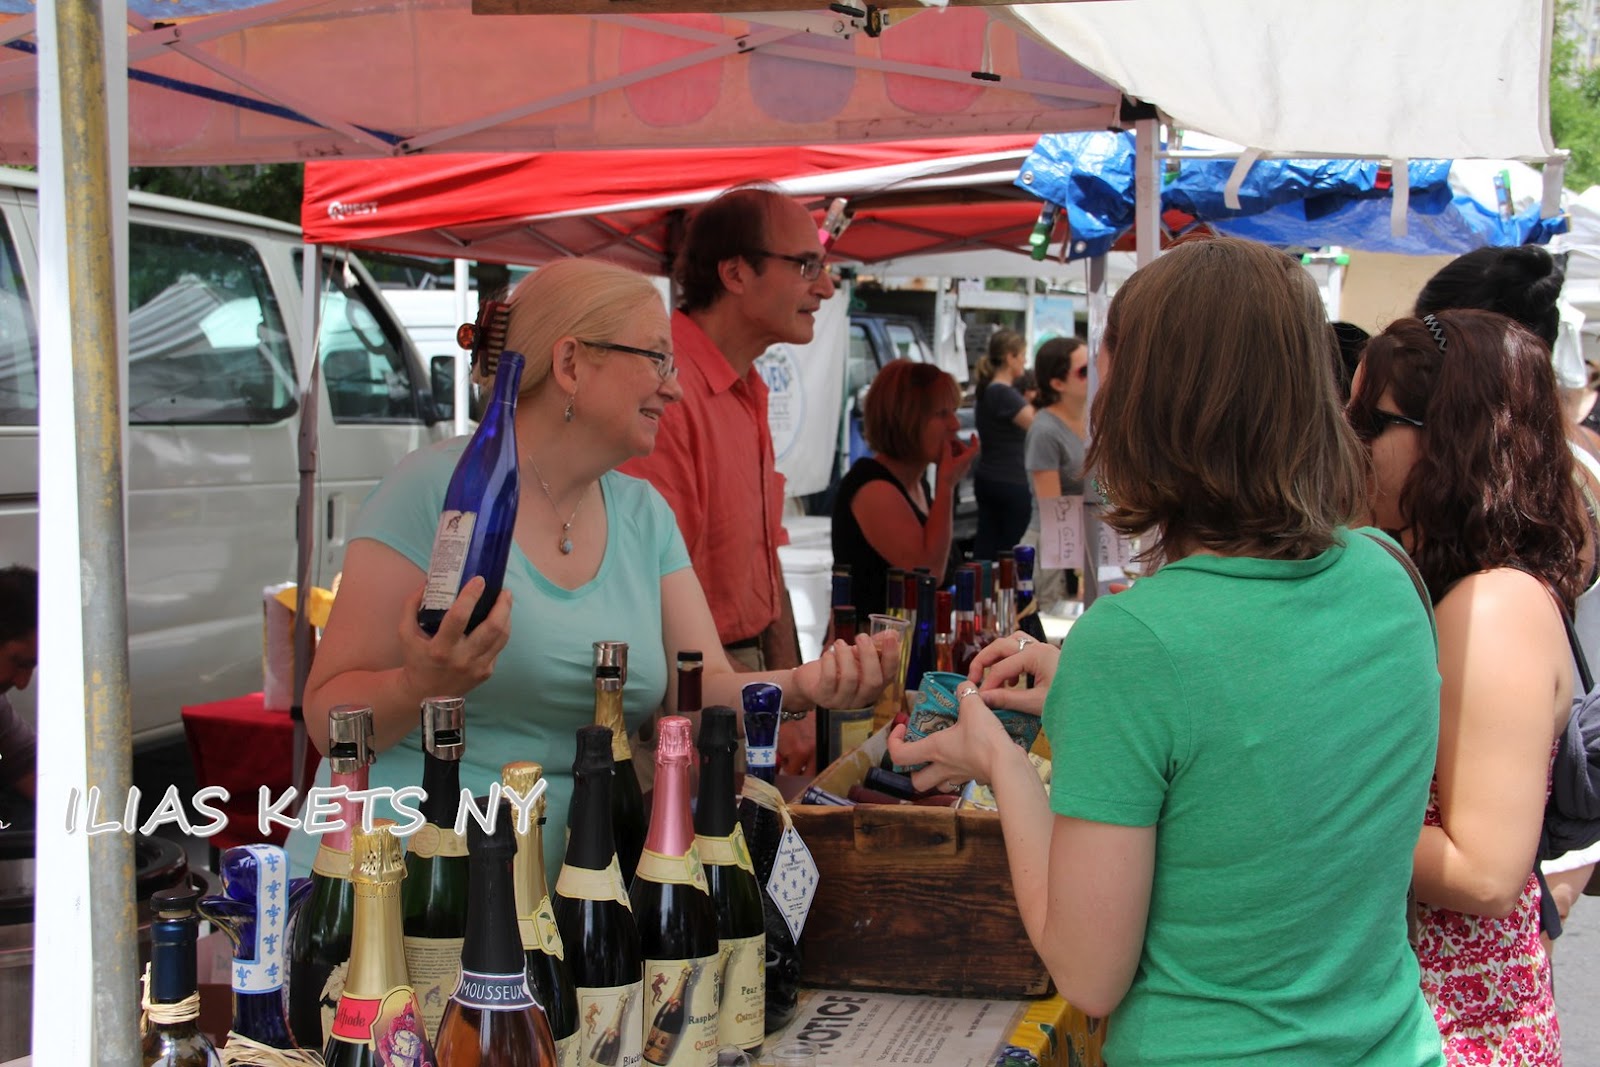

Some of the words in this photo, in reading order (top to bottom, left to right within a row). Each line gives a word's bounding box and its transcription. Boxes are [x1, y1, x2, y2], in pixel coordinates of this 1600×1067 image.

[327, 201, 379, 220] QUEST
[460, 980, 525, 1001] MOUSSEUX
[741, 986, 758, 996] Pear
